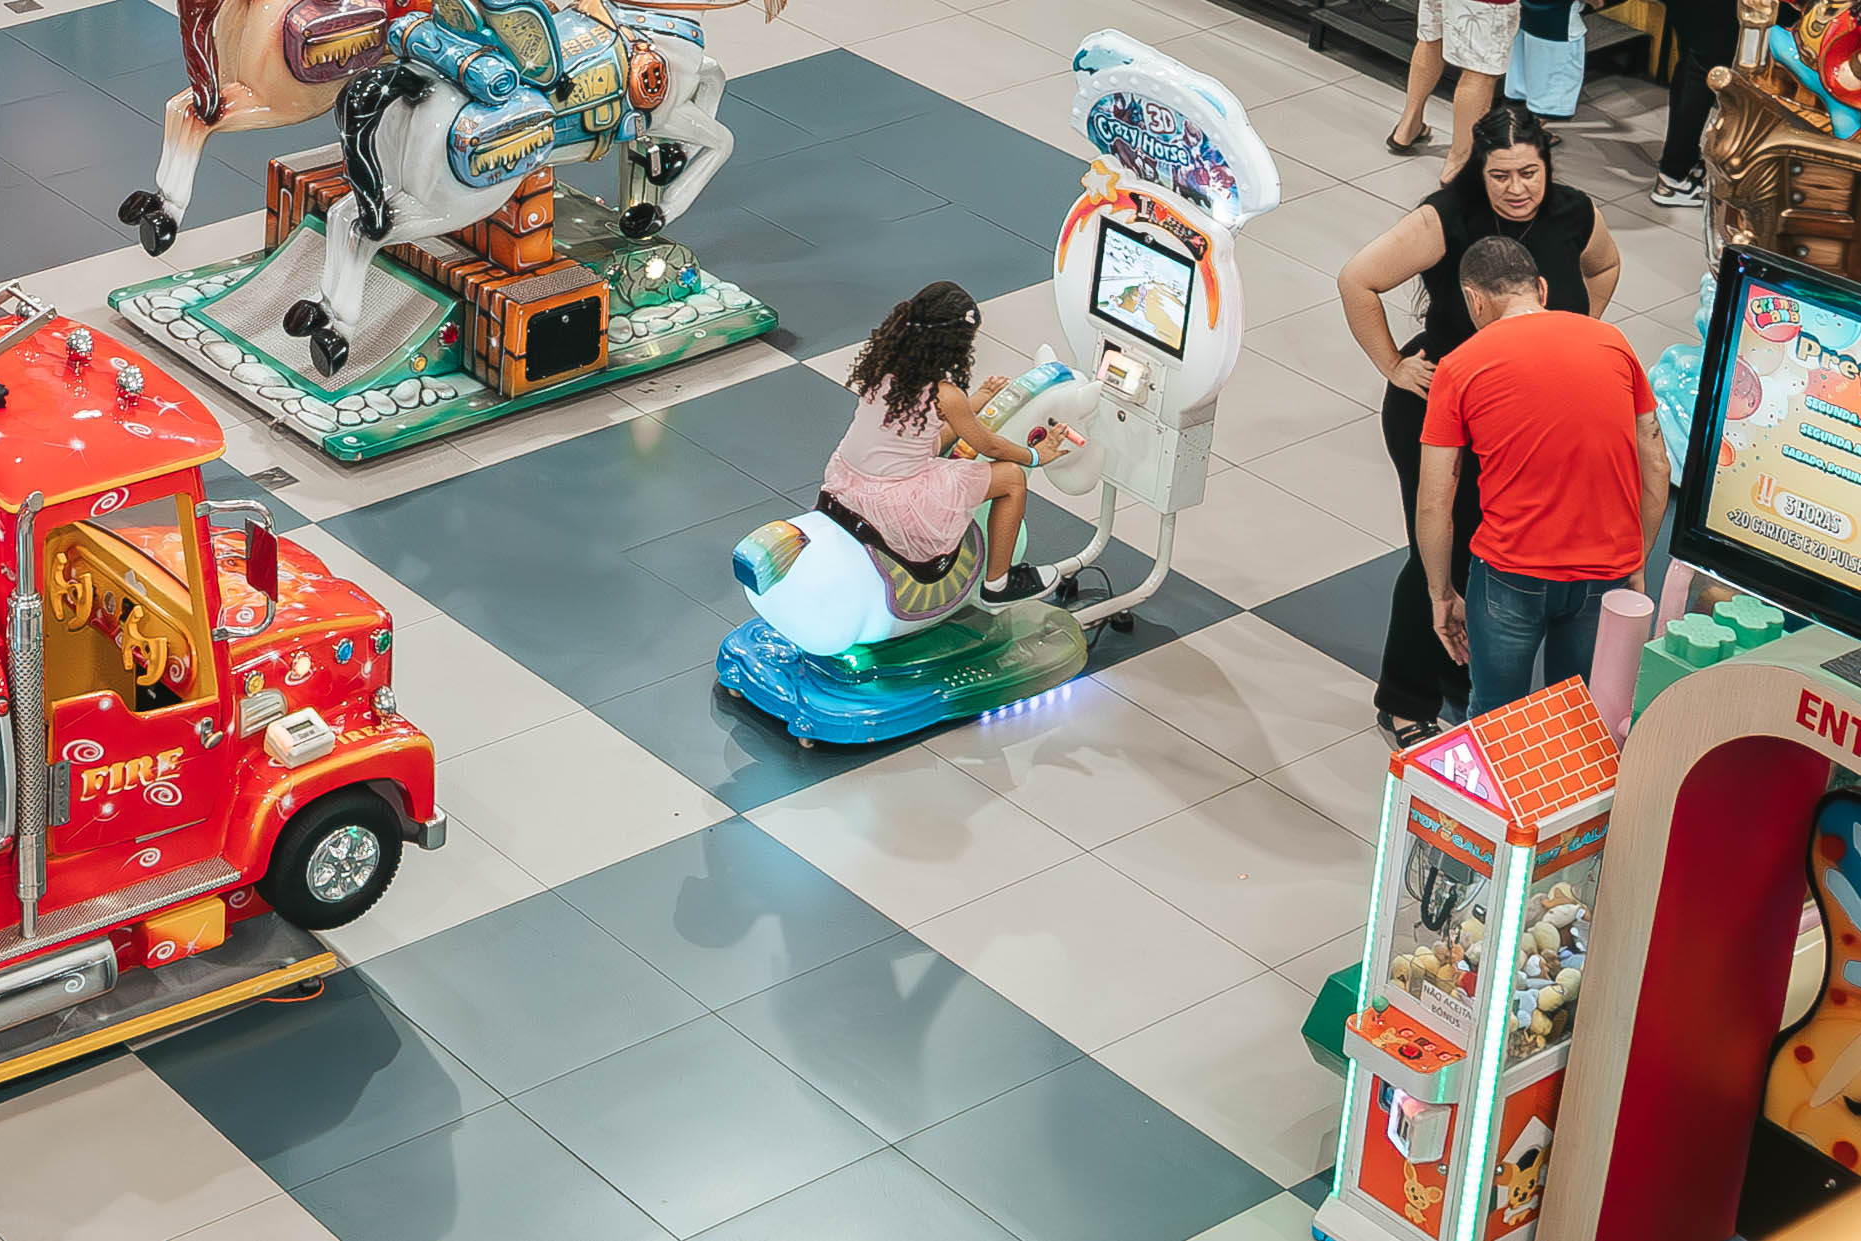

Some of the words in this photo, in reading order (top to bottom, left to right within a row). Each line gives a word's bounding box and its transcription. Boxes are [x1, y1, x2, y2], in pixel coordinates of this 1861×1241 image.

[1145, 102, 1177, 135] 3D
[1095, 114, 1140, 150] Crazy
[1141, 134, 1189, 165] Horse
[1796, 334, 1861, 380] Pre
[1804, 394, 1858, 427] SEGUNDA
[1799, 423, 1852, 452] SEGUNDA
[1784, 495, 1795, 515] 3
[1794, 500, 1842, 535] HORAS
[1802, 536, 1812, 554] E
[1811, 540, 1829, 560] 20
[336, 725, 380, 745] IRE
[79, 747, 184, 803] FIRE
[1423, 984, 1442, 1001] NÃO
